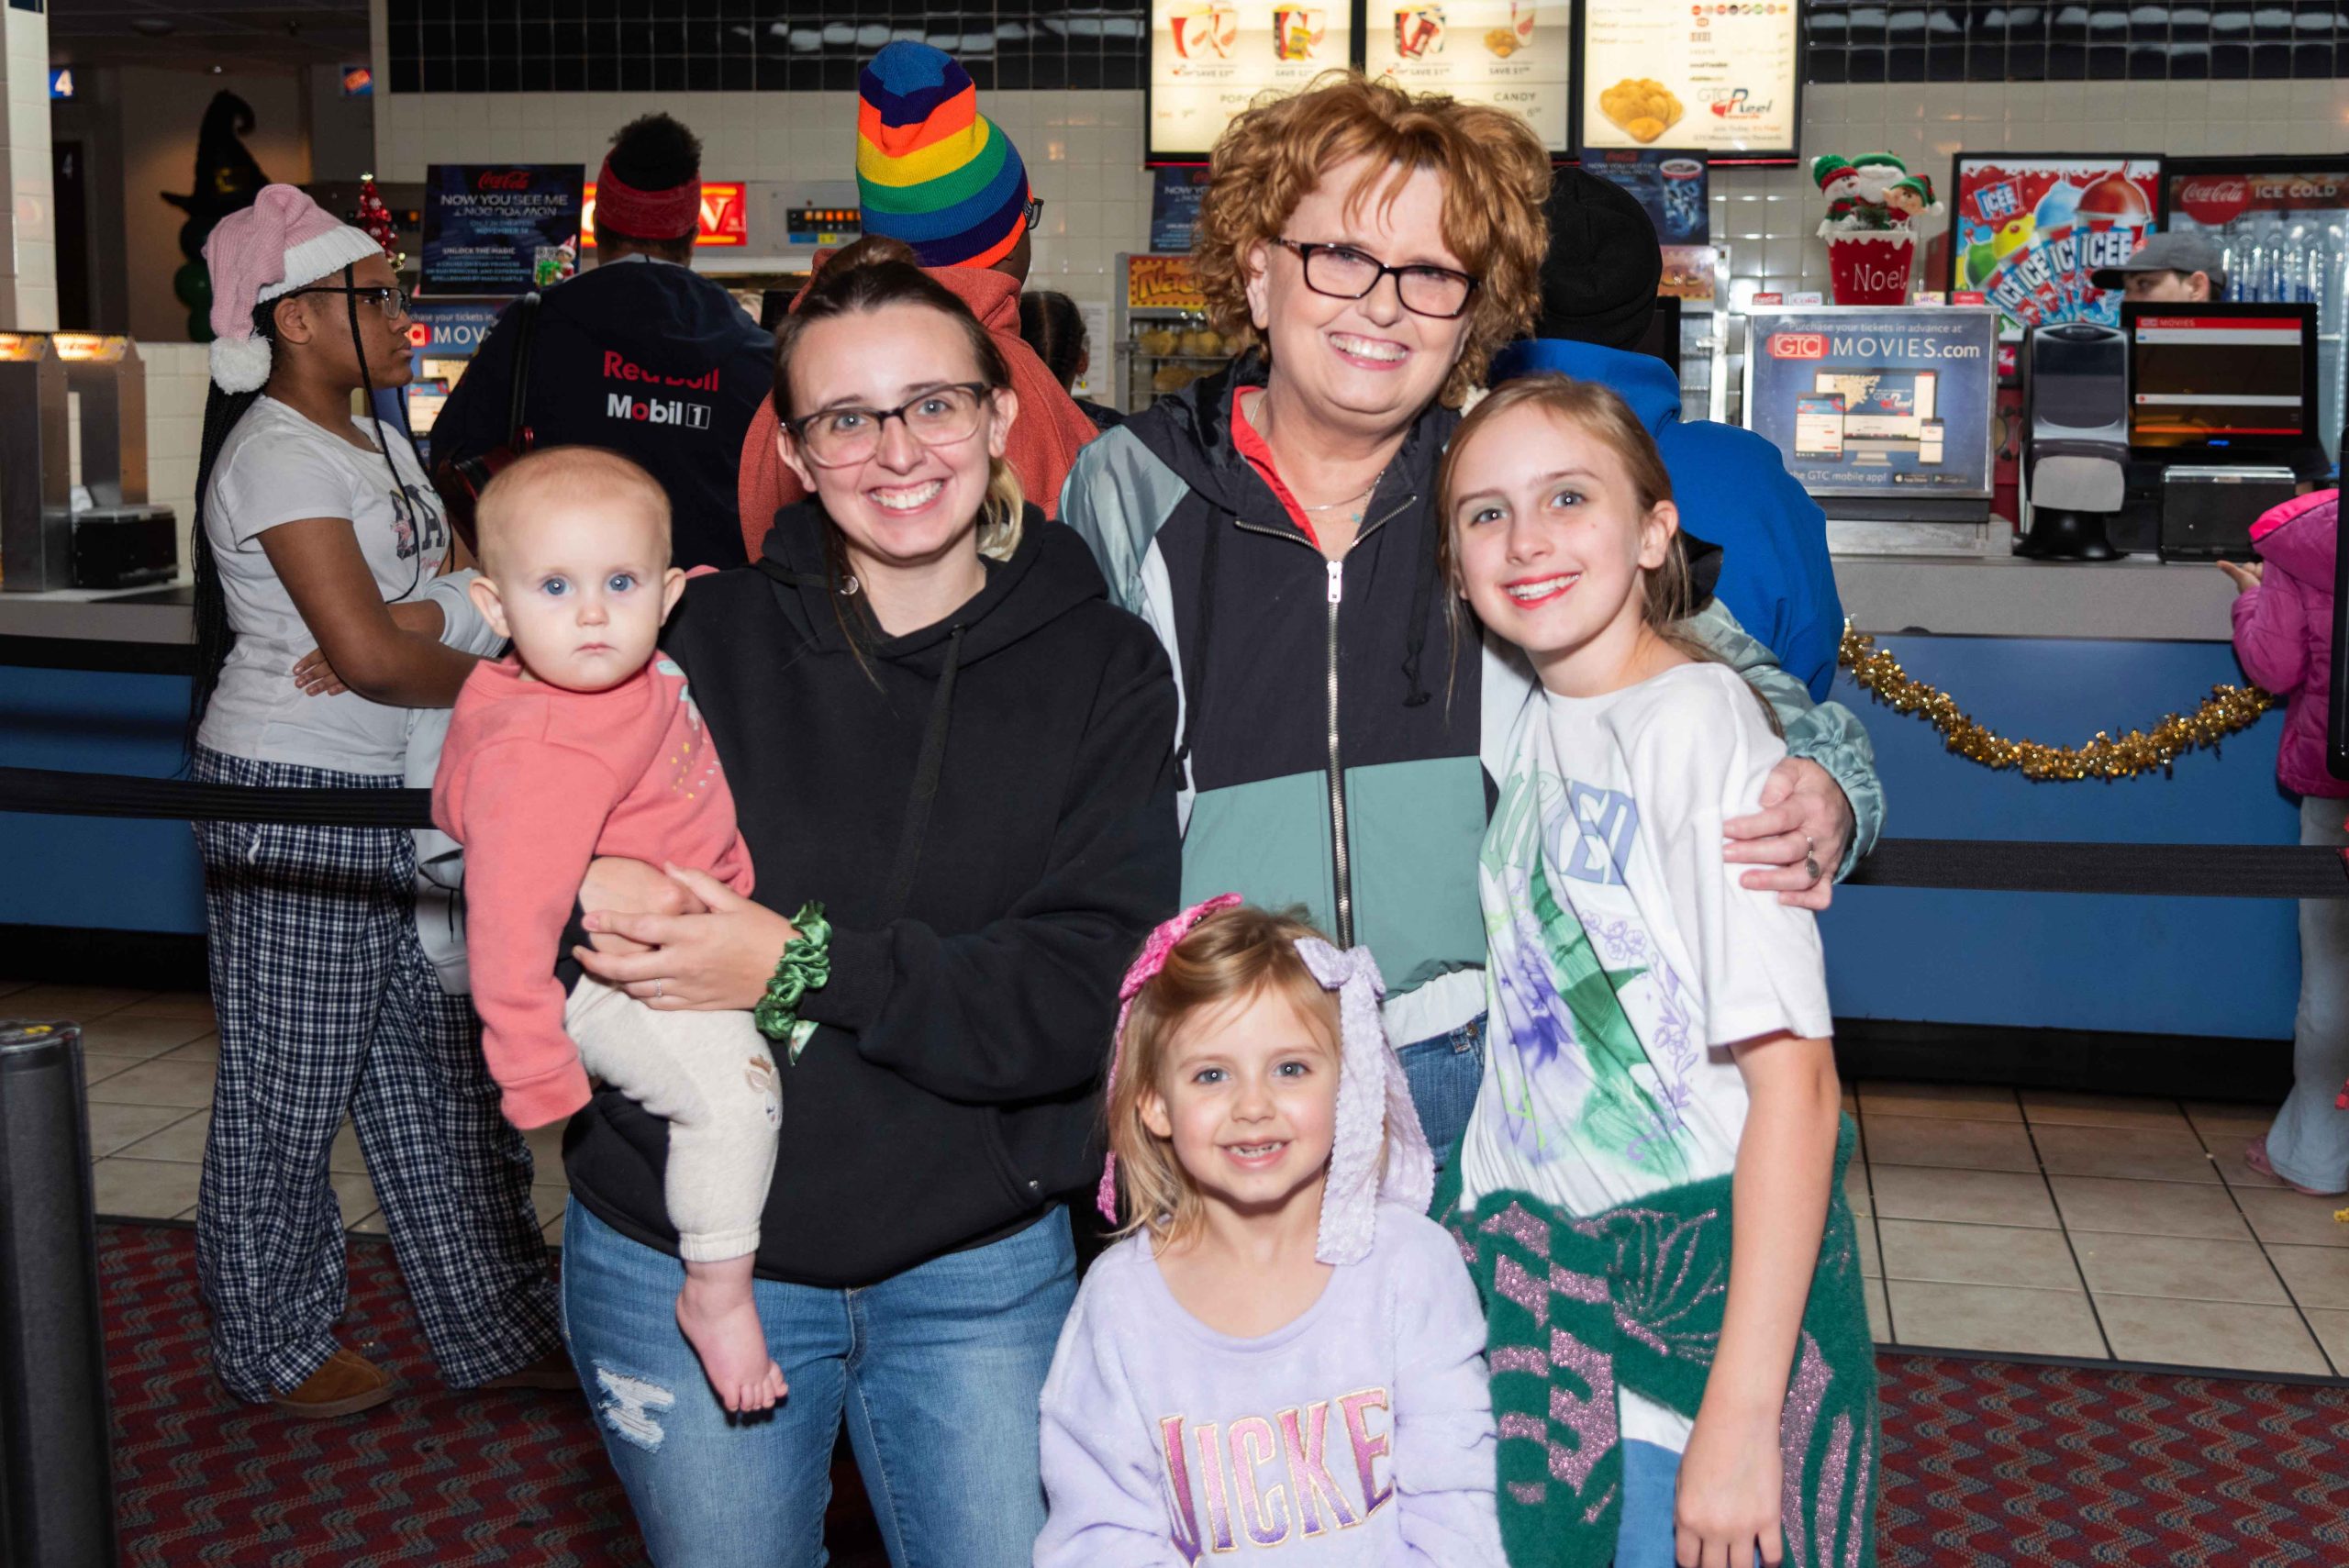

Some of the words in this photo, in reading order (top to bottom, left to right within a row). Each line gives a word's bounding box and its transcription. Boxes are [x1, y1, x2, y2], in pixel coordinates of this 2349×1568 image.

[55, 69, 73, 96] 4
[1494, 92, 1537, 102] CANDY
[440, 194, 478, 206] NOW
[480, 194, 511, 206] YOU
[513, 194, 543, 206] SEE
[544, 194, 569, 206] ME
[1981, 187, 2018, 214] ICEE
[2255, 185, 2284, 199] ICE
[2288, 184, 2337, 198] COLD
[2049, 236, 2076, 274] IC
[2081, 231, 2132, 267] ICEE
[1854, 262, 1908, 292] Noel
[2015, 248, 2052, 292] ICE
[410, 313, 433, 322] chase
[435, 315, 453, 324] your
[455, 312, 484, 322] tickets
[1789, 322, 1833, 333] Purchase
[1835, 325, 1858, 335] your
[1860, 323, 1894, 333] tickets
[1895, 324, 1905, 333] in
[1908, 323, 1950, 334] advance
[1952, 326, 1963, 334] at
[433, 325, 486, 345] MOV
[1776, 336, 1821, 357] GTC
[607, 393, 684, 426] Mobil
[1808, 471, 1830, 482] GTC
[1831, 471, 1864, 482] mobile
[1160, 1386, 1395, 1568] ICKE
